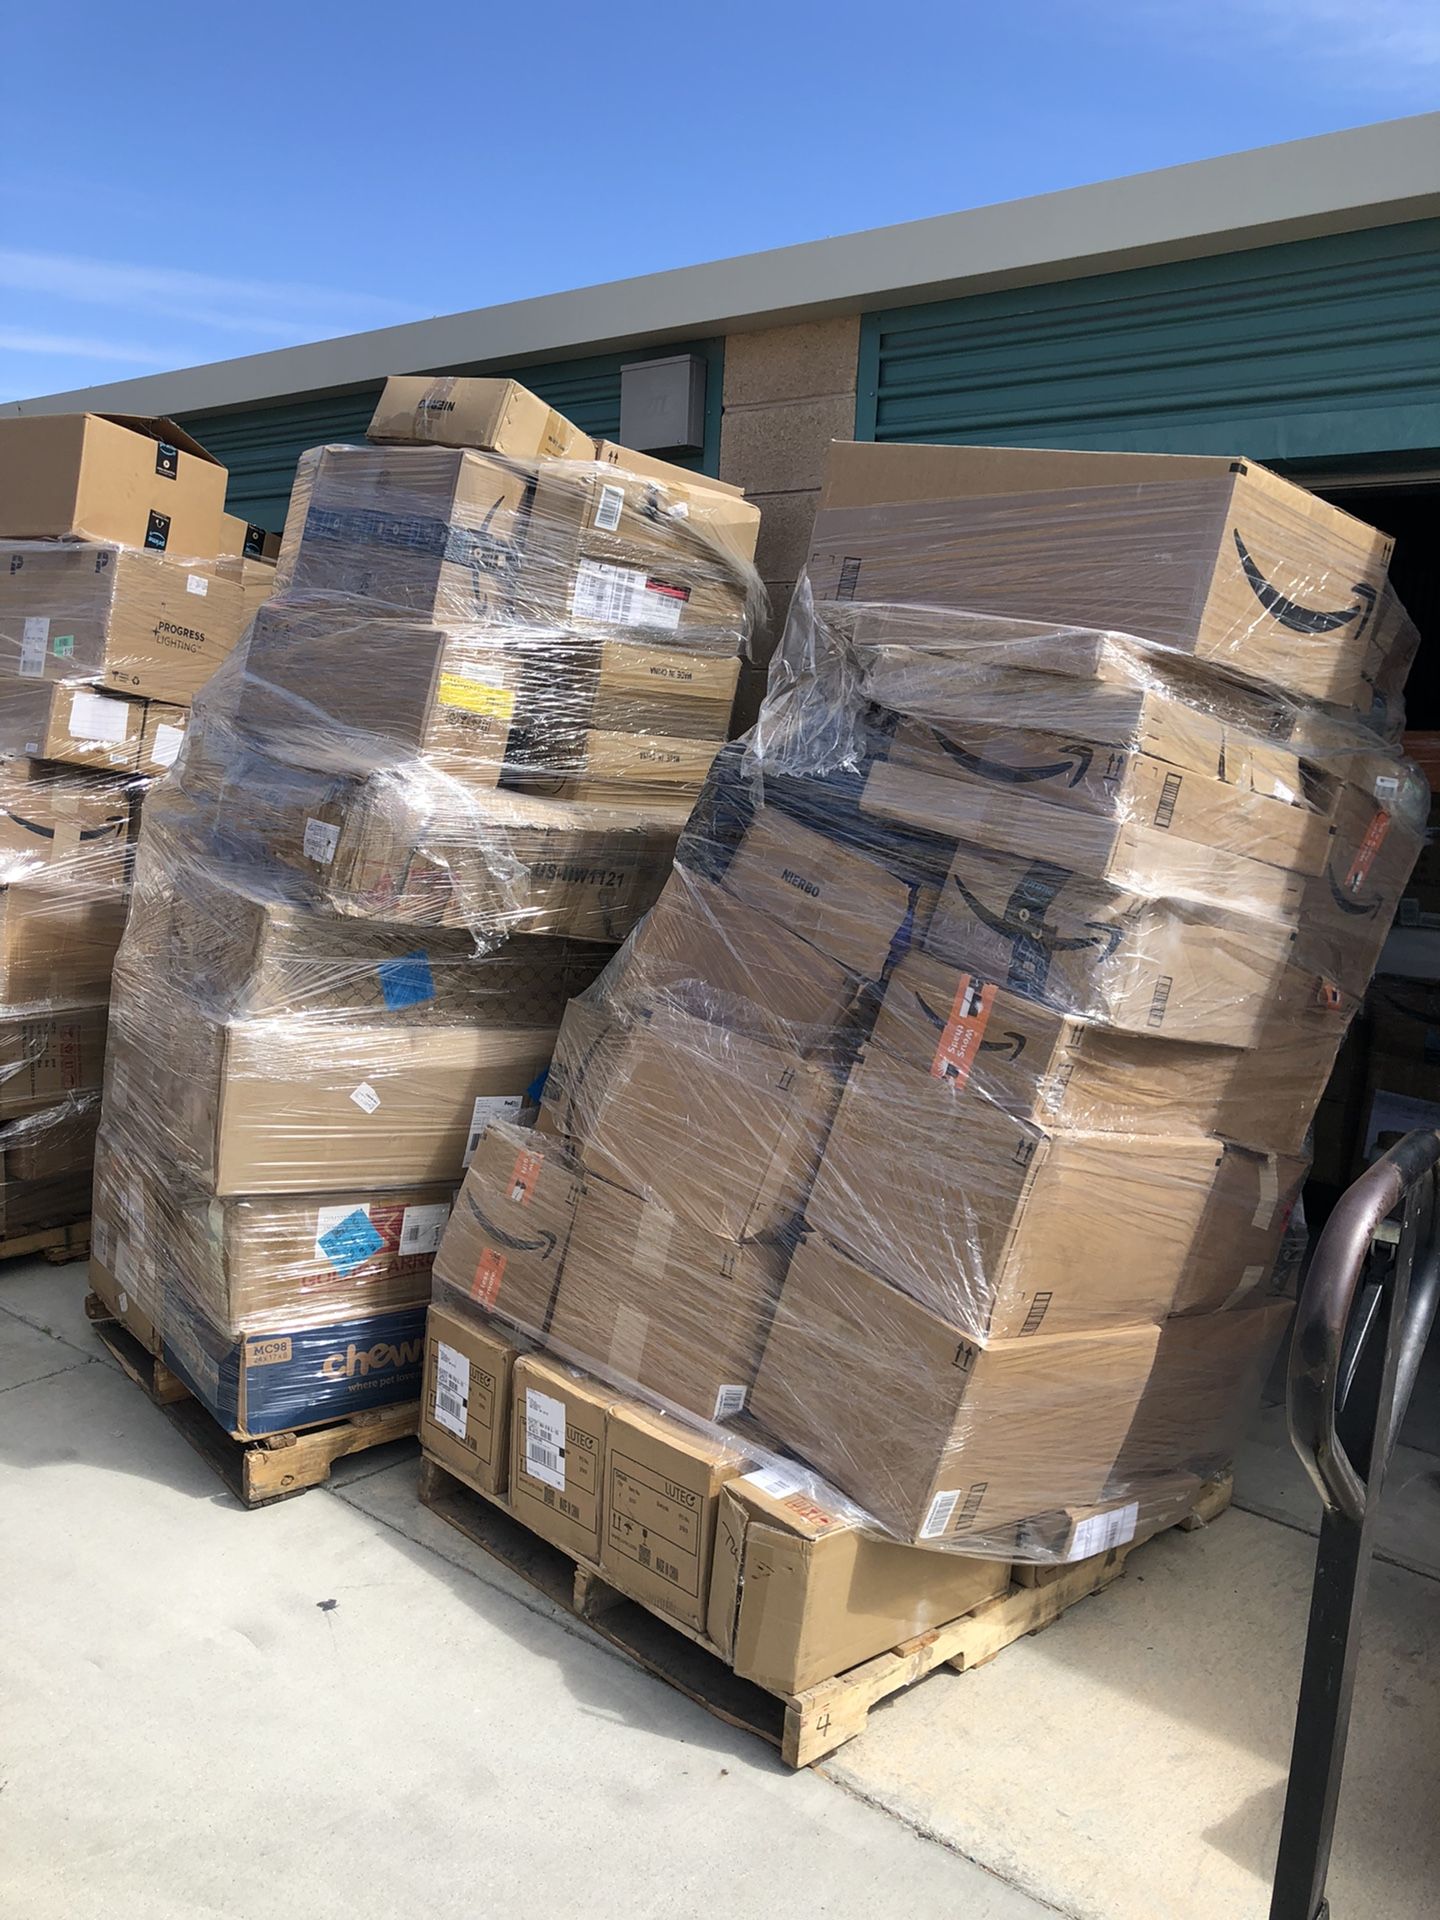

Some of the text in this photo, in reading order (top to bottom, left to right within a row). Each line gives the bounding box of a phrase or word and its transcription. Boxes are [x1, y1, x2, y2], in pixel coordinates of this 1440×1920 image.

[158, 621, 206, 642] PROGRESS
[156, 635, 197, 654] LIGHTING
[780, 868, 820, 898] NIERBO
[253, 1341, 288, 1357] MC98
[322, 1338, 424, 1379] chew
[347, 1380, 379, 1392] where
[379, 1376, 395, 1389] pet
[566, 1426, 594, 1450] LUTEC
[664, 1481, 696, 1508] LUTEC
[816, 1712, 832, 1738] 4
